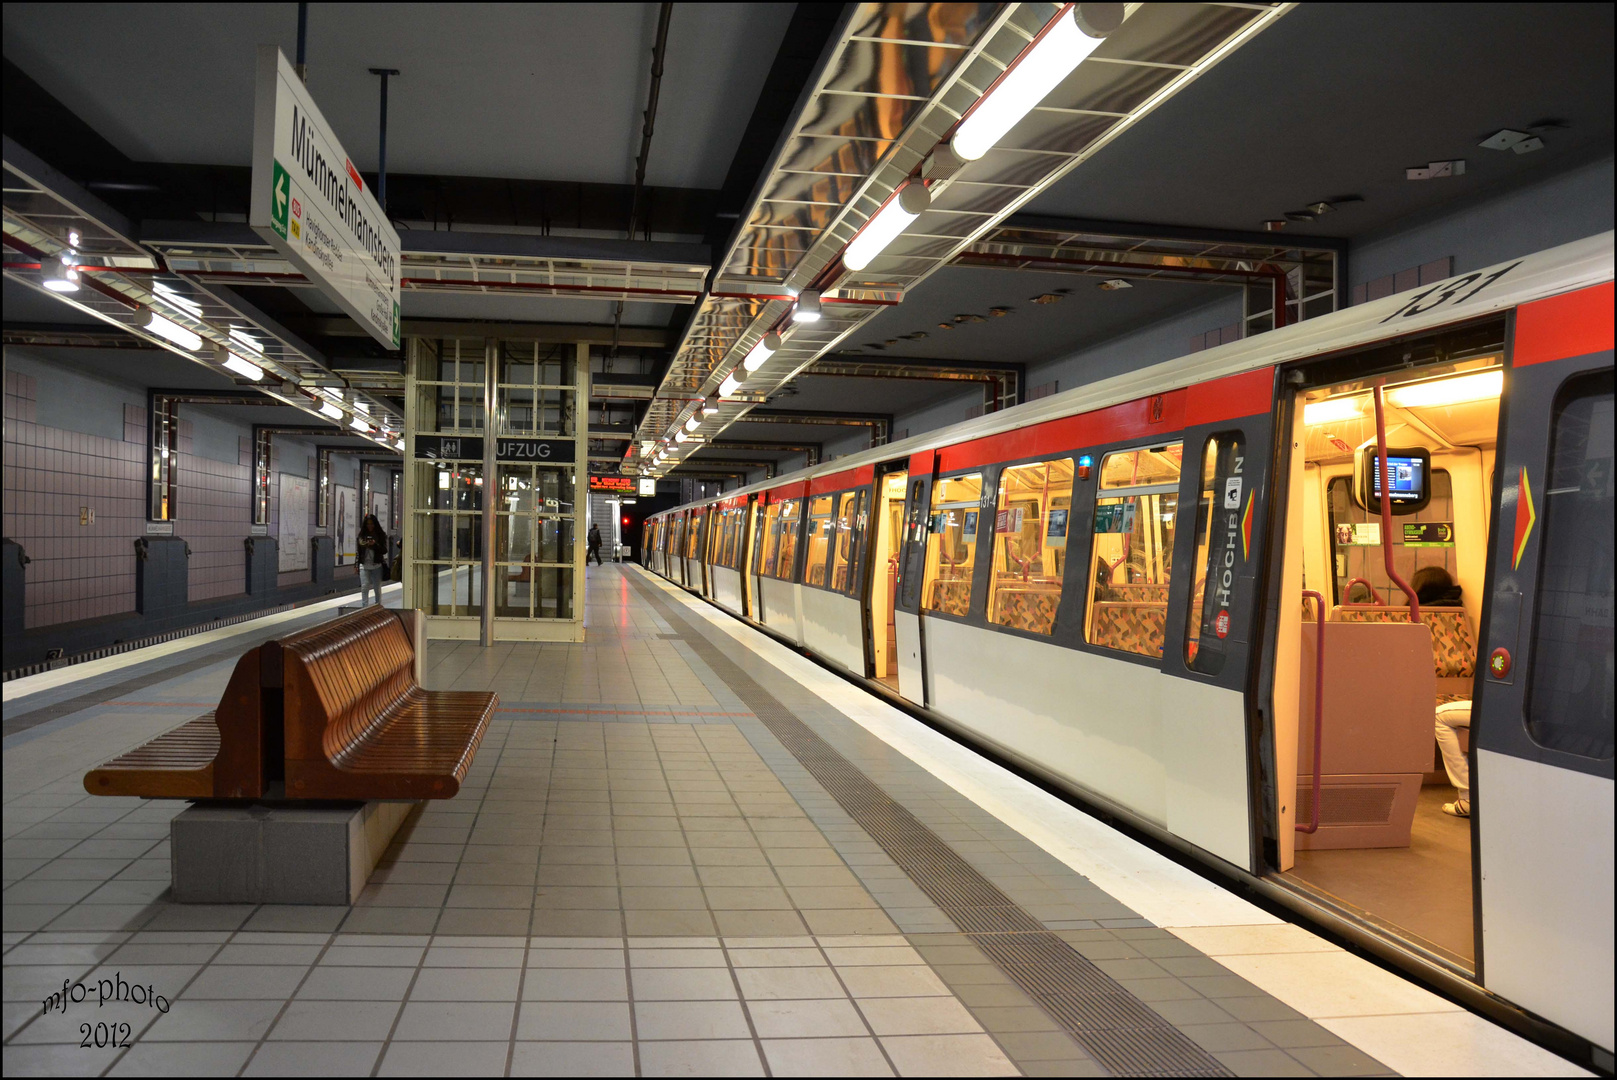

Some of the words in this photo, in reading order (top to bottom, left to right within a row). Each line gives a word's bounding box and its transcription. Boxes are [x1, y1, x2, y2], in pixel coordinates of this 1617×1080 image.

[291, 104, 395, 292] Mümmelmannsberg
[1378, 260, 1525, 324] 131
[496, 443, 551, 457] UFZUG
[1221, 456, 1244, 607] HOCHBN
